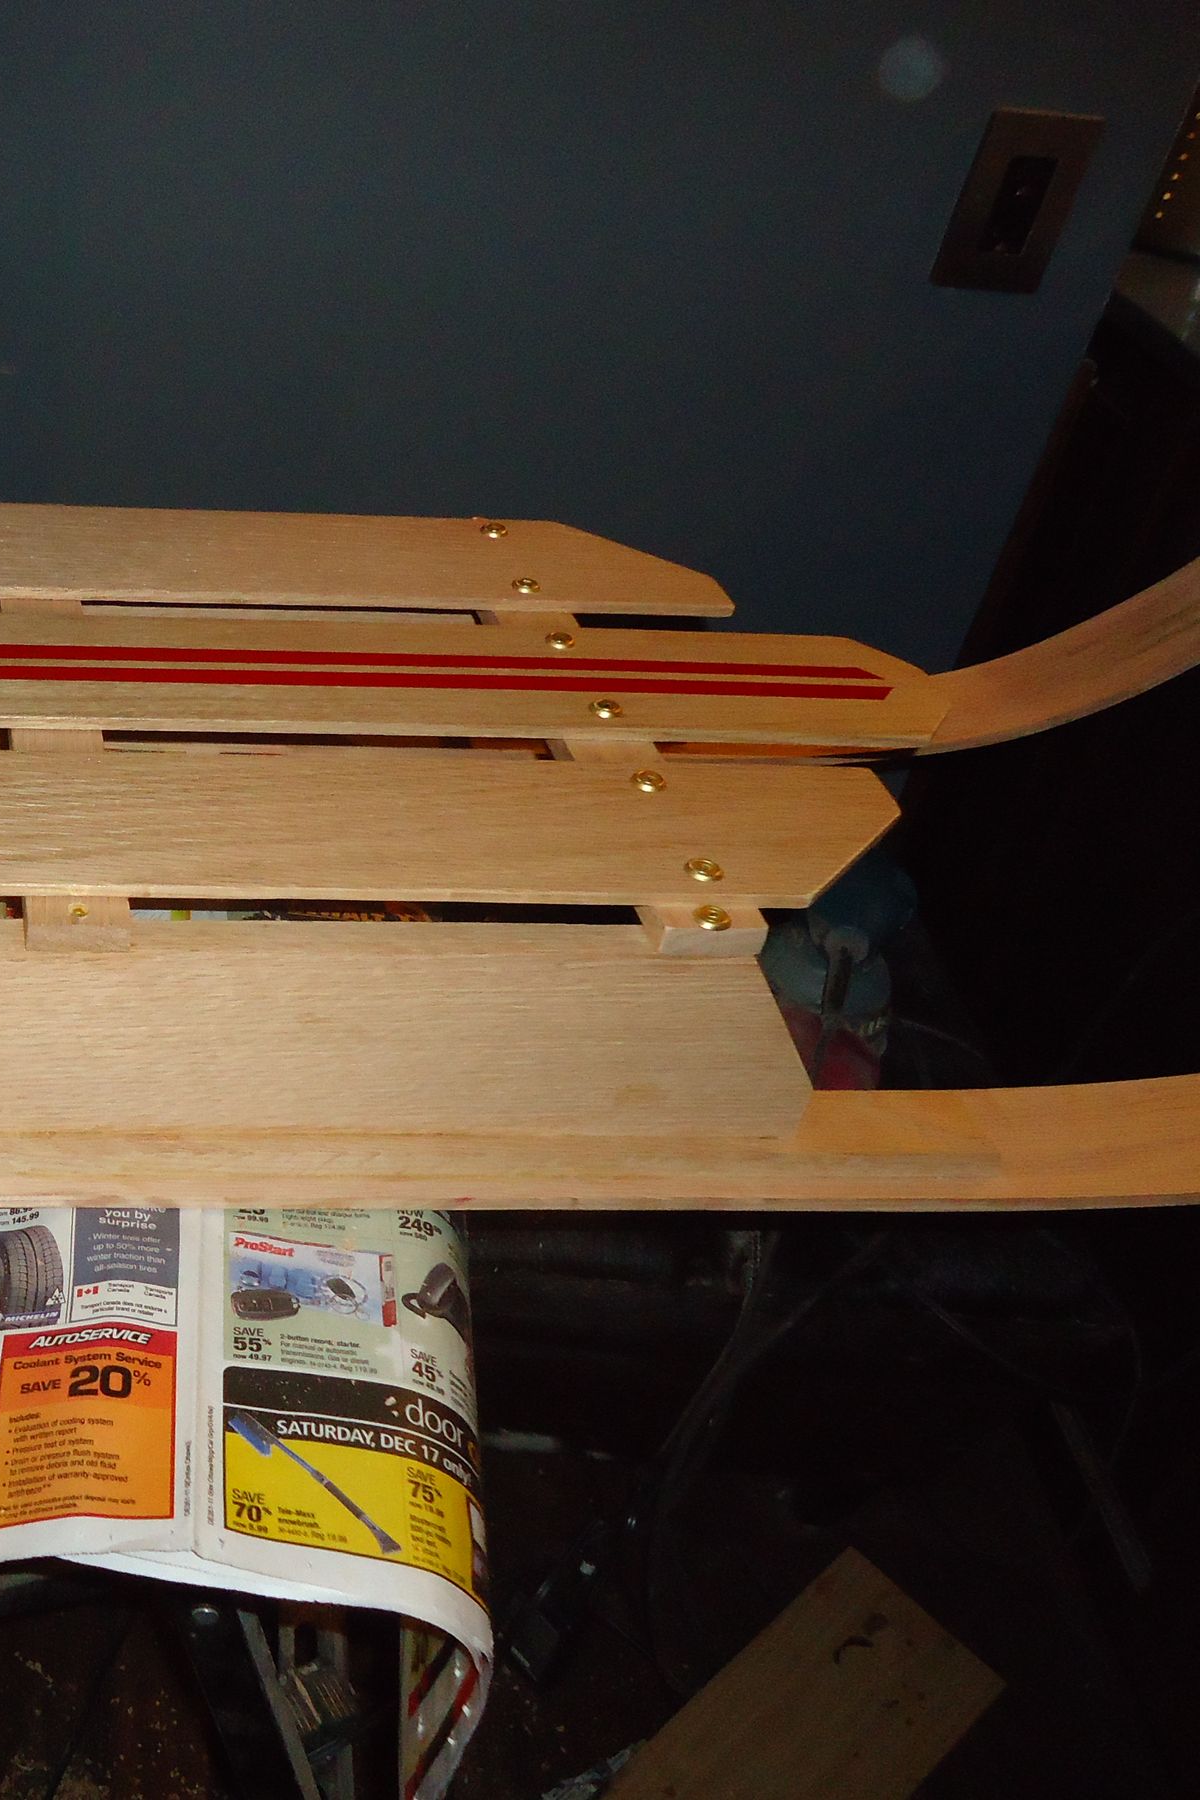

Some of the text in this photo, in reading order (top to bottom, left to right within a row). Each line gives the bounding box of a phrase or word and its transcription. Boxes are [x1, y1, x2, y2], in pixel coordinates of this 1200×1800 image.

[11, 1211, 39, 1224] 145.99
[104, 1209, 130, 1218] you
[134, 1210, 150, 1222] by
[98, 1217, 157, 1230] surprise
[142, 1236, 161, 1244] offer
[93, 1243, 104, 1251] up
[234, 1237, 296, 1258] ProStart
[87, 1252, 166, 1265] winter traction than
[143, 1290, 166, 1300] Canada
[5, 1311, 58, 1322] MICHELIN
[233, 1327, 264, 1337] SAVE
[280, 1333, 310, 1343] 2-button
[13, 1352, 162, 1370] Coolant System Service
[248, 1353, 273, 1362] 49.97
[410, 1348, 438, 1367] SAVE
[20, 1378, 61, 1394] SAVE
[59, 1417, 85, 1427] cooling
[87, 1418, 114, 1427] system
[405, 1398, 465, 1448] door
[55, 1426, 77, 1437] report
[275, 1418, 375, 1449] SATURDAY,
[378, 1433, 417, 1456] DEC
[421, 1444, 440, 1463] 17
[40, 1451, 71, 1462] pressure
[407, 1466, 437, 1486] SAVE
[232, 1488, 265, 1505] SAVE
